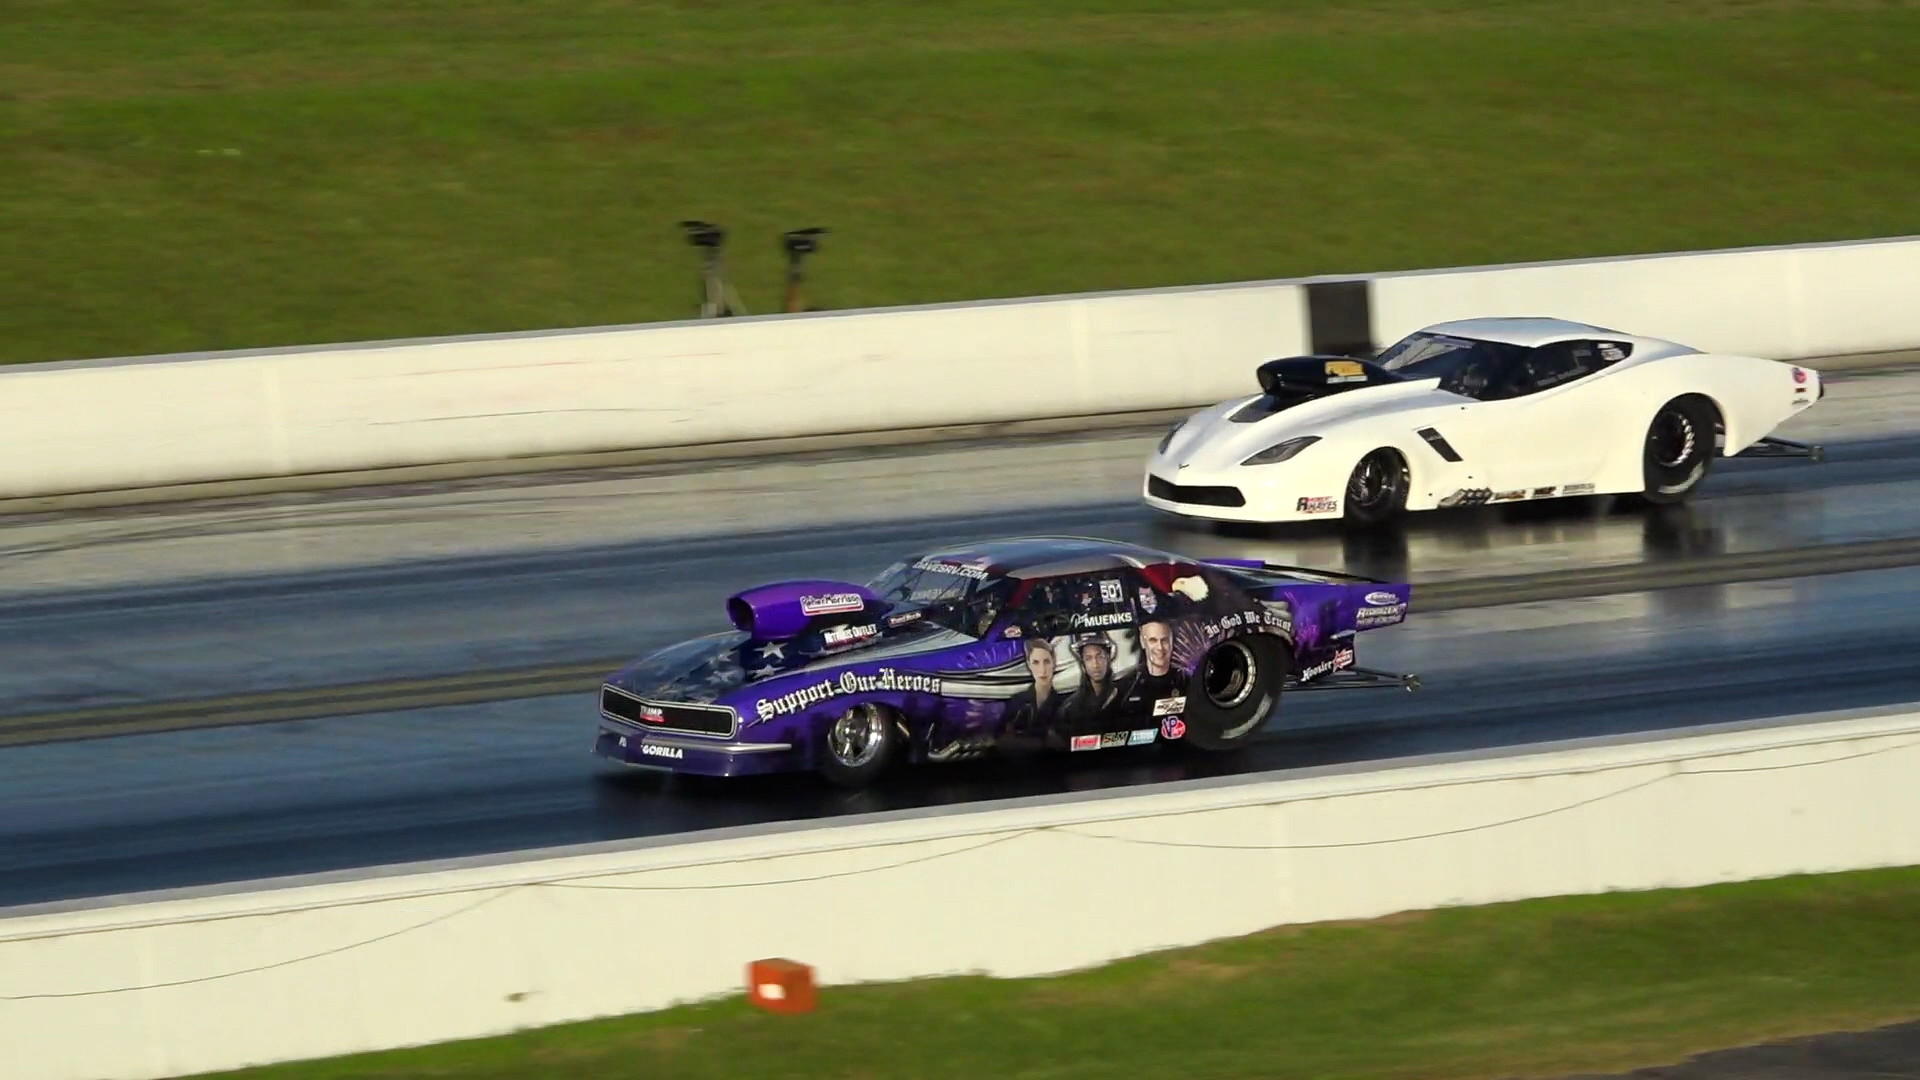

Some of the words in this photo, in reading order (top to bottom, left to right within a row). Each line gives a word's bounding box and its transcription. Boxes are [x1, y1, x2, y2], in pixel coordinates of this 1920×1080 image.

[1100, 581, 1122, 598] 501
[1084, 612, 1132, 628] MUENKS
[1221, 614, 1243, 629] God
[1244, 611, 1260, 624] We
[1264, 611, 1291, 632] Trust
[756, 679, 836, 723] Support
[840, 671, 876, 694] Our
[879, 667, 941, 693] Heroes
[642, 744, 683, 759] GORILLA
